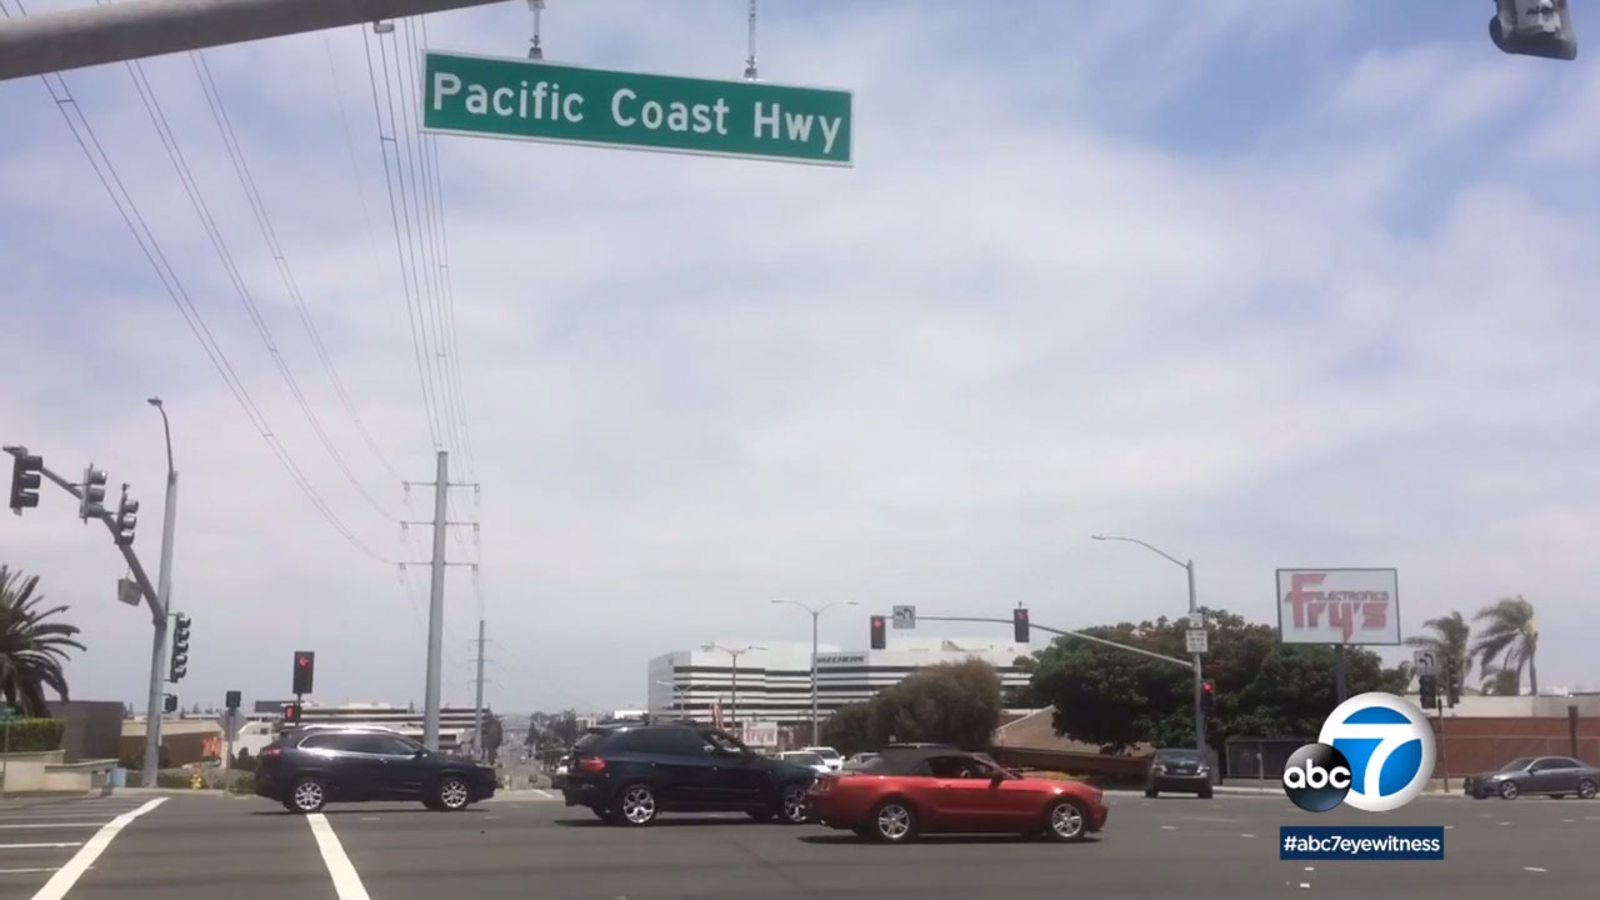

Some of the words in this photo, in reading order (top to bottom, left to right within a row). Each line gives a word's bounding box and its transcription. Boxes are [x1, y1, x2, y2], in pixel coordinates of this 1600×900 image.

[433, 72, 585, 123] Pacific
[610, 88, 730, 135] Coast
[753, 101, 842, 154] Hwy
